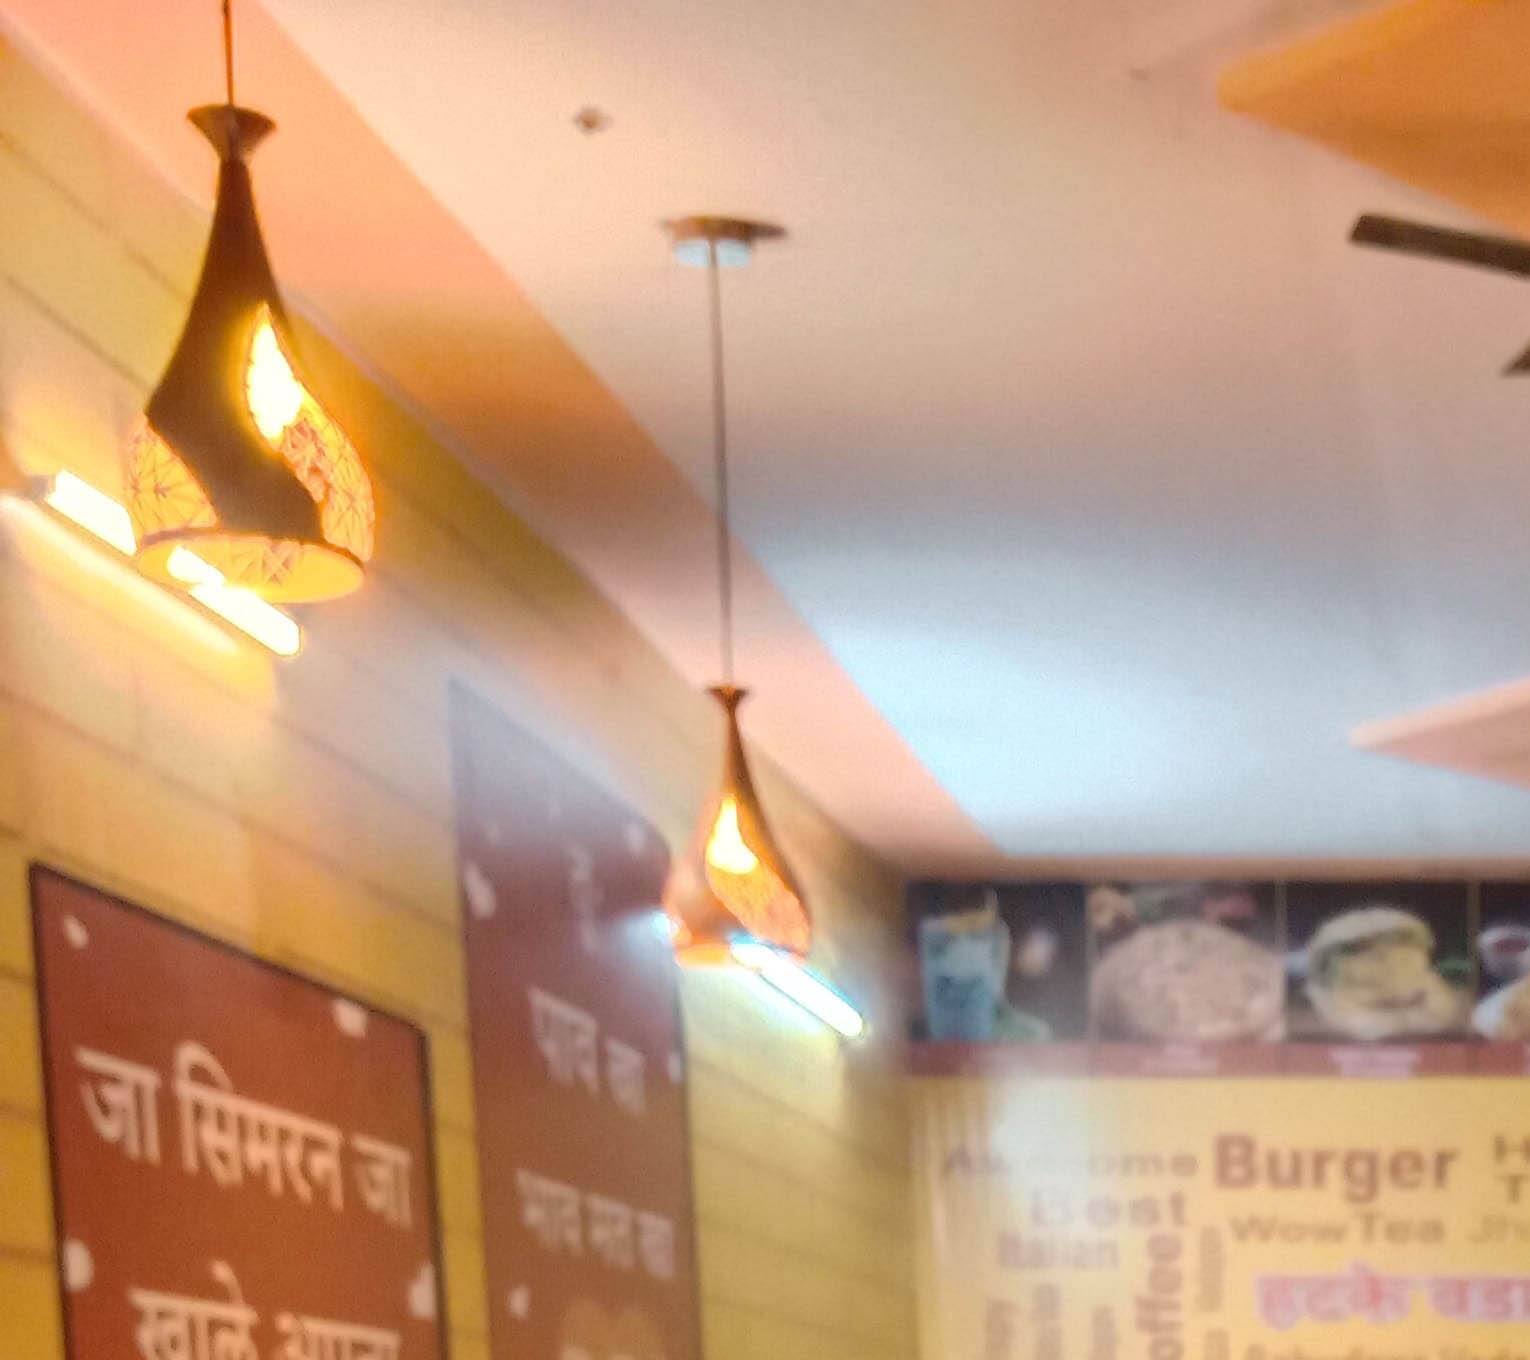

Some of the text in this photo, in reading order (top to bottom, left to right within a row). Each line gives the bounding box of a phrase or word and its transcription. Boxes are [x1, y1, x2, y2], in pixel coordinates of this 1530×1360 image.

[77, 1041, 413, 1230] जा सिमरन जा
[1214, 1133, 1459, 1204] Burger
